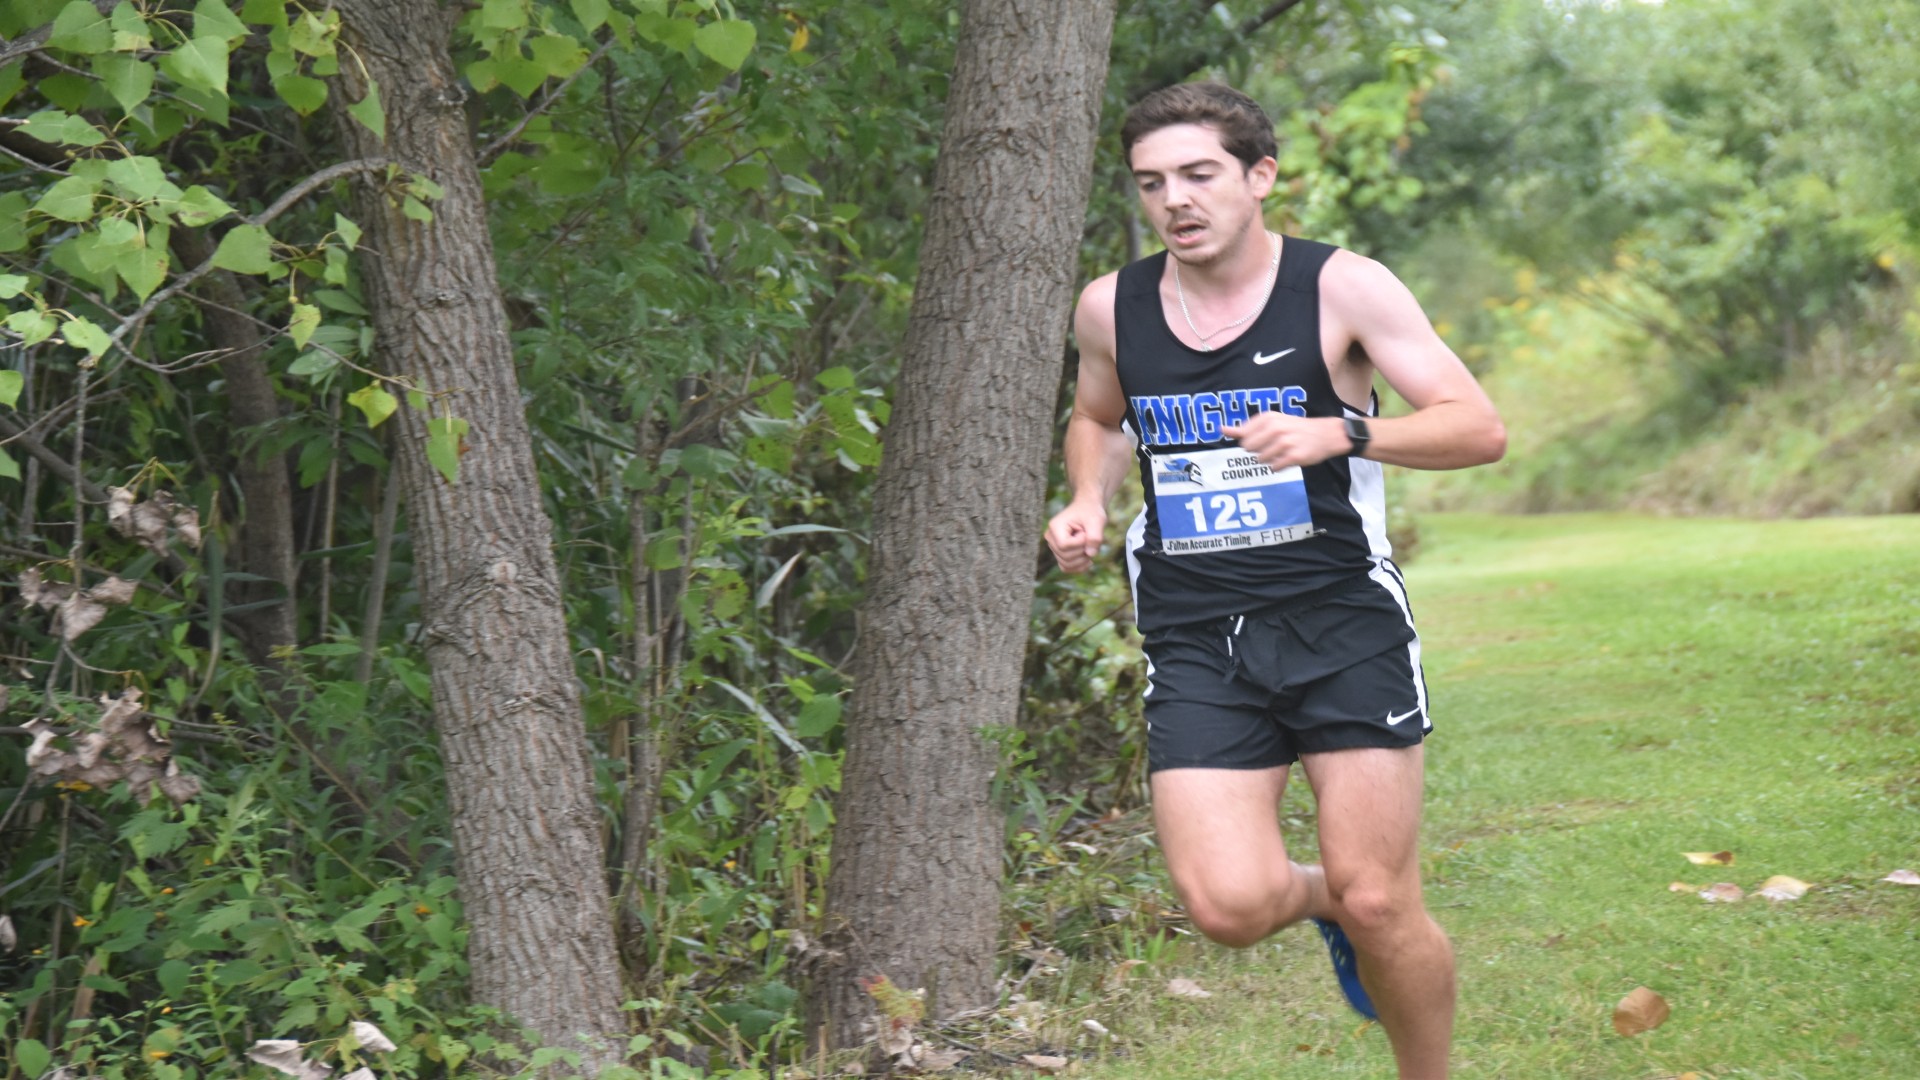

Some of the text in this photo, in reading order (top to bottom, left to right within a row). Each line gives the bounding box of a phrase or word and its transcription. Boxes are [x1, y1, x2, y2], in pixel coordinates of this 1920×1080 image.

[1226, 455, 1259, 468] CROS
[1185, 491, 1268, 533] 125
[1189, 537, 1223, 550] Accurate
[1223, 534, 1252, 547] Timing
